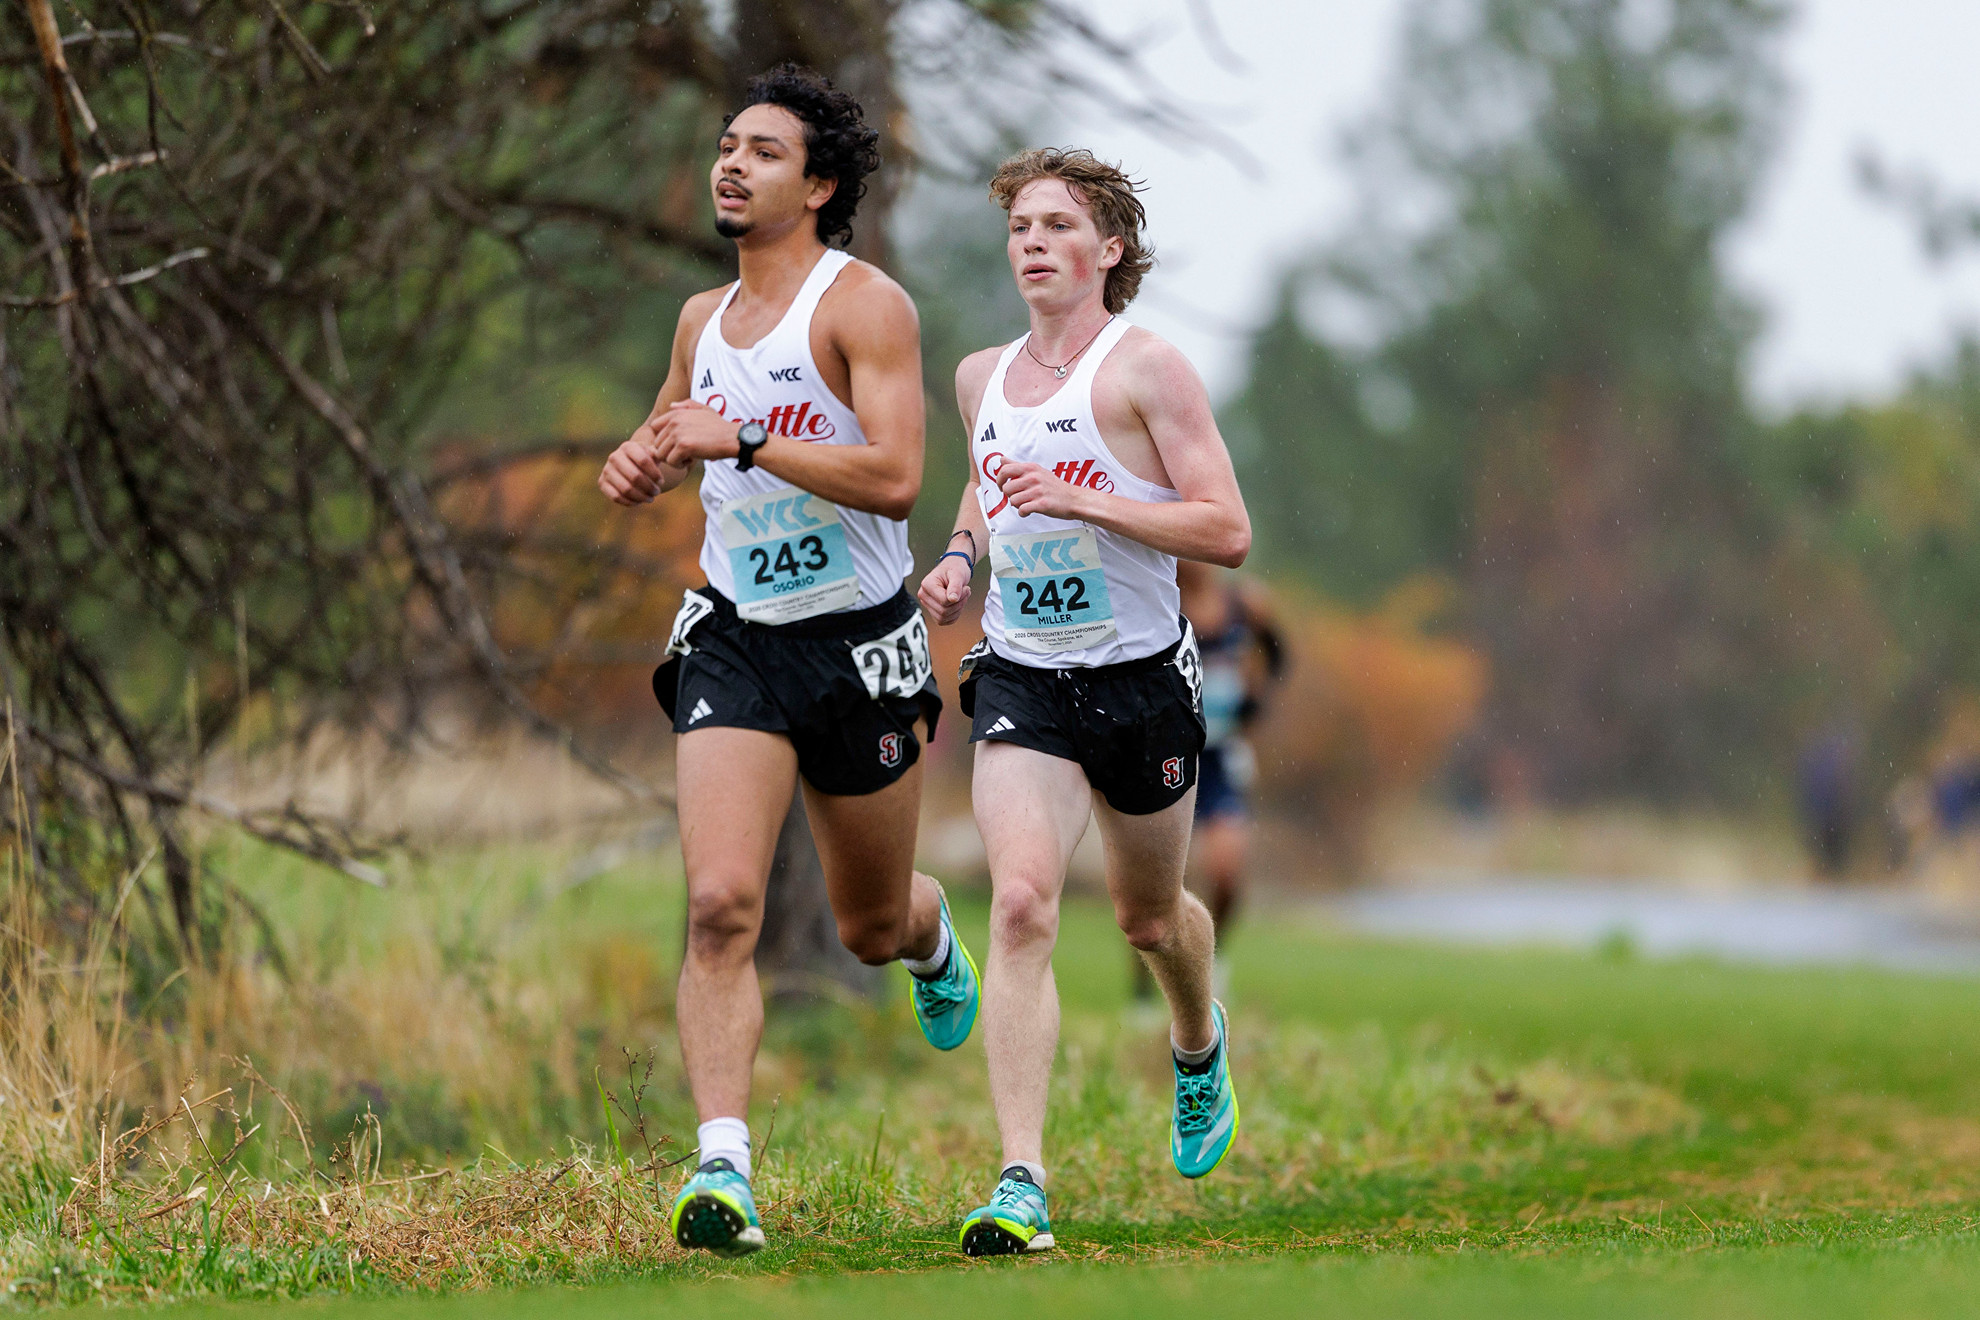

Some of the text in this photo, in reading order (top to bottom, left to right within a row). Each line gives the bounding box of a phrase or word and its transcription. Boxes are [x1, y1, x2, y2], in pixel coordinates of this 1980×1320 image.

[768, 366, 802, 382] WCC
[706, 393, 836, 443] ttle
[1045, 418, 1078, 433] WCC
[982, 451, 1115, 520] Sttle
[731, 491, 822, 538] WCC
[749, 535, 828, 585] 243
[1001, 536, 1086, 575] WCC
[773, 576, 815, 593] OSORIO
[1016, 576, 1090, 615] 242
[1038, 614, 1073, 624] MILLER
[1041, 630, 1063, 638] COUNTRY
[1065, 625, 1107, 635] CHAMPIONSHIPS
[863, 621, 931, 698] 243
